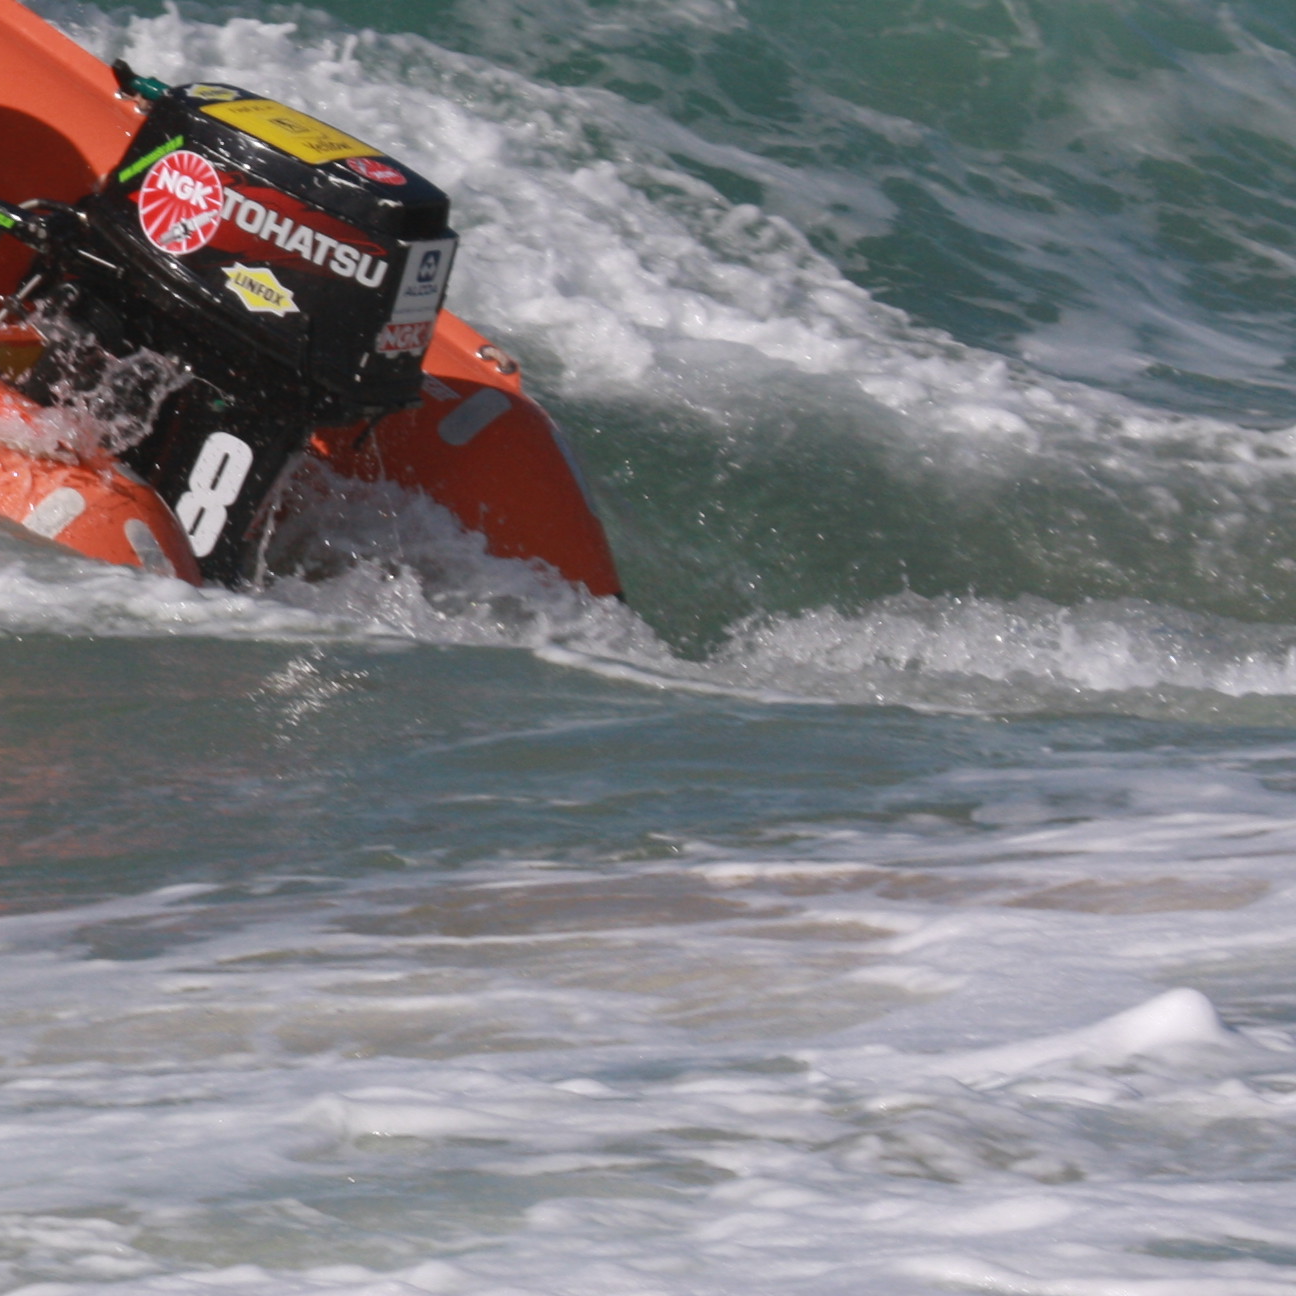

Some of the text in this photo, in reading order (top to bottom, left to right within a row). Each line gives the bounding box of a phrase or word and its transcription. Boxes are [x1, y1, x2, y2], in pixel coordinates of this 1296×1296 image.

[157, 167, 214, 210] NGK
[221, 187, 388, 288] TOHATSU
[233, 272, 285, 307] LINFOX
[175, 431, 253, 557] 8
